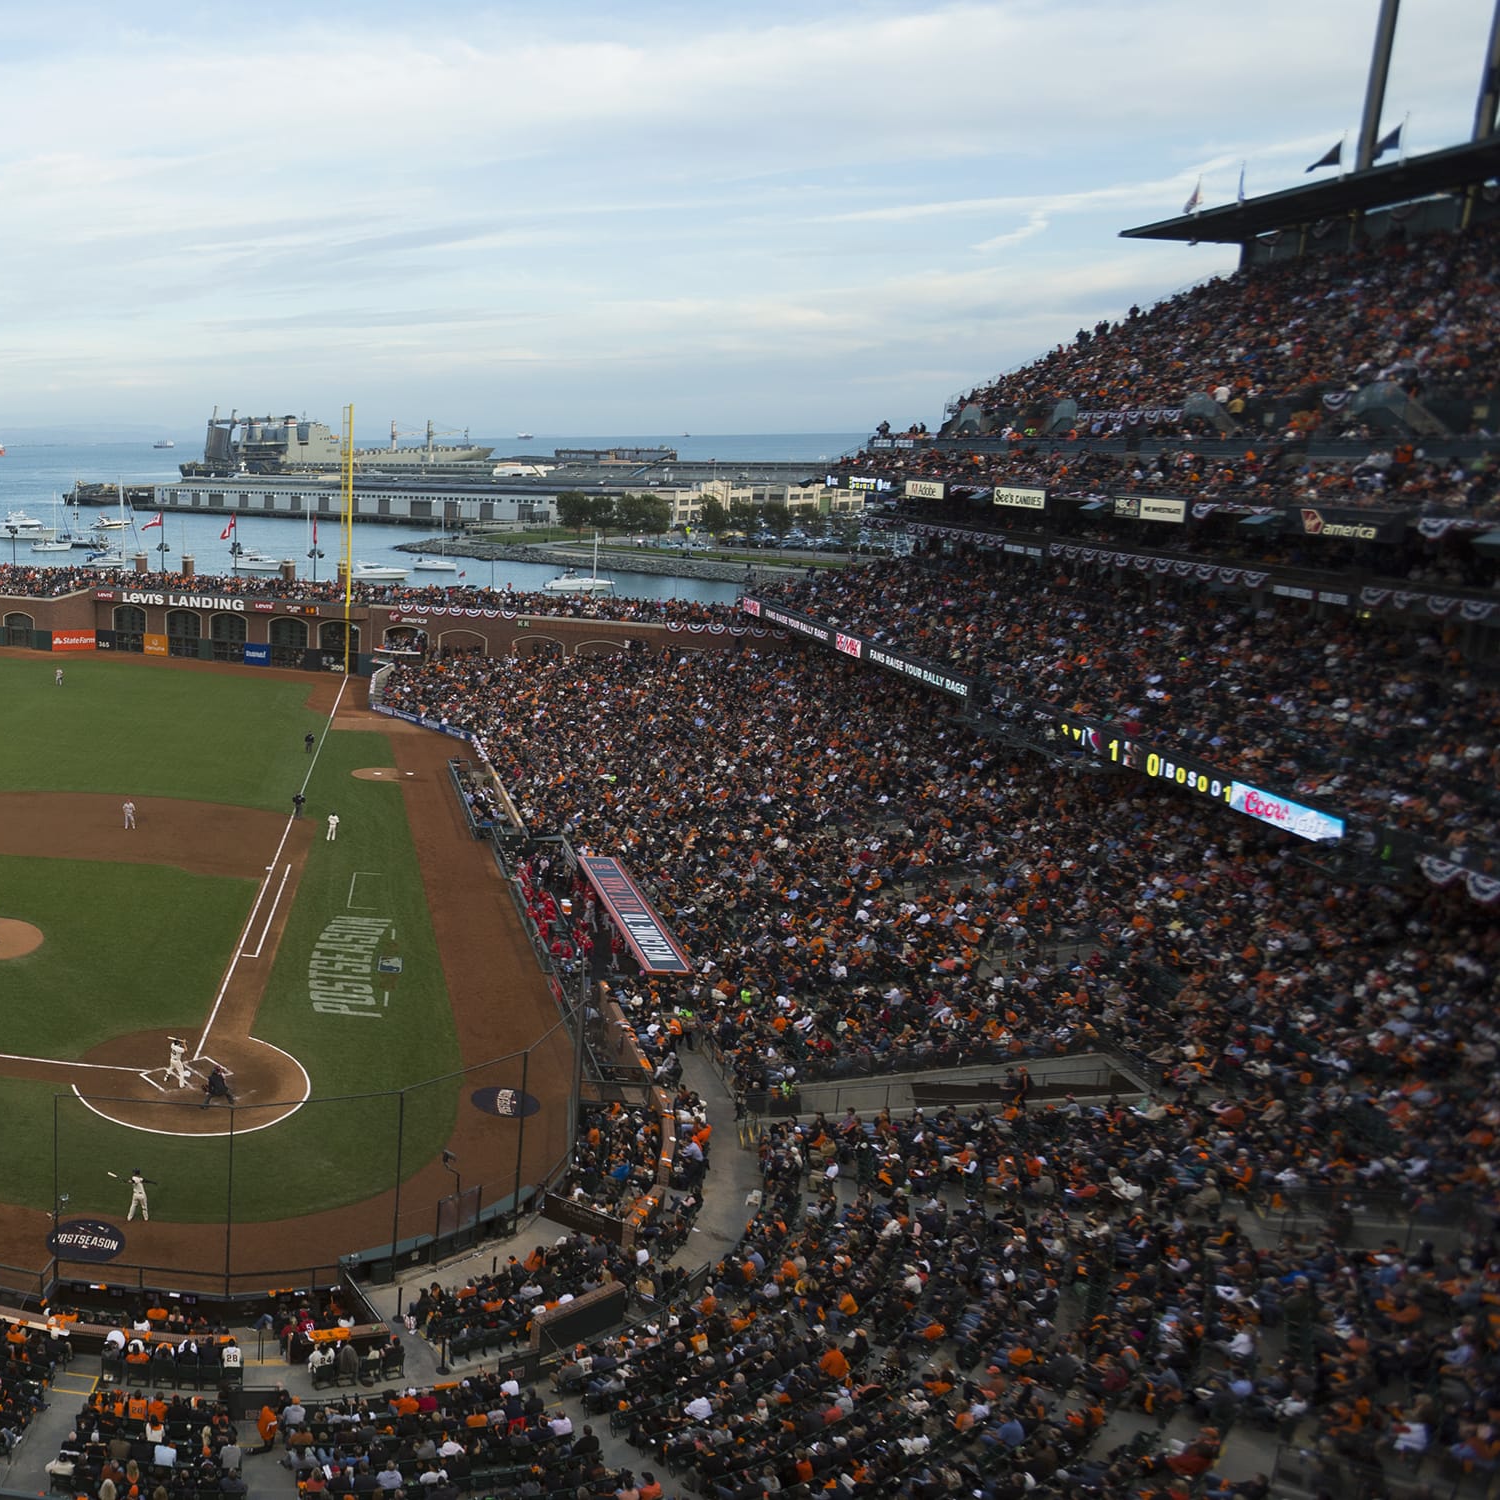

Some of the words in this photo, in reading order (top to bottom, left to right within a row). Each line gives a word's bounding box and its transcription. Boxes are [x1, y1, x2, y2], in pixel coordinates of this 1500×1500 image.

[919, 484, 936, 496] Adobe
[996, 489, 1014, 503] See's
[1015, 495, 1042, 506] CANDIES
[1153, 506, 1181, 514] INVESTIGATE
[1322, 523, 1377, 539] america
[169, 595, 245, 611] LANDING
[765, 609, 776, 620] FANS
[776, 613, 788, 625] RAISE
[788, 618, 800, 630] YOUR
[800, 623, 814, 635] RALLY
[814, 628, 829, 640] RAGS!
[836, 632, 861, 658] RE/MAX
[869, 649, 885, 663] FANS
[885, 656, 904, 671] RAISE
[904, 662, 922, 678] YOUR
[922, 670, 945, 687] RALLY
[945, 679, 968, 696] RAGS!
[1108, 739, 1119, 761] 1
[1165, 762, 1176, 779] B
[1187, 771, 1198, 787] S
[1222, 786, 1232, 802] 1
[1244, 791, 1289, 820] Coors
[599, 877, 628, 893] PARK
[611, 895, 644, 912] AT&T
[621, 914, 652, 922] TO
[628, 924, 677, 960] WELCOME
[308, 915, 392, 1017] POSTSEASON
[305, 1322, 315, 1332] 51
[226, 1354, 238, 1363] 28
